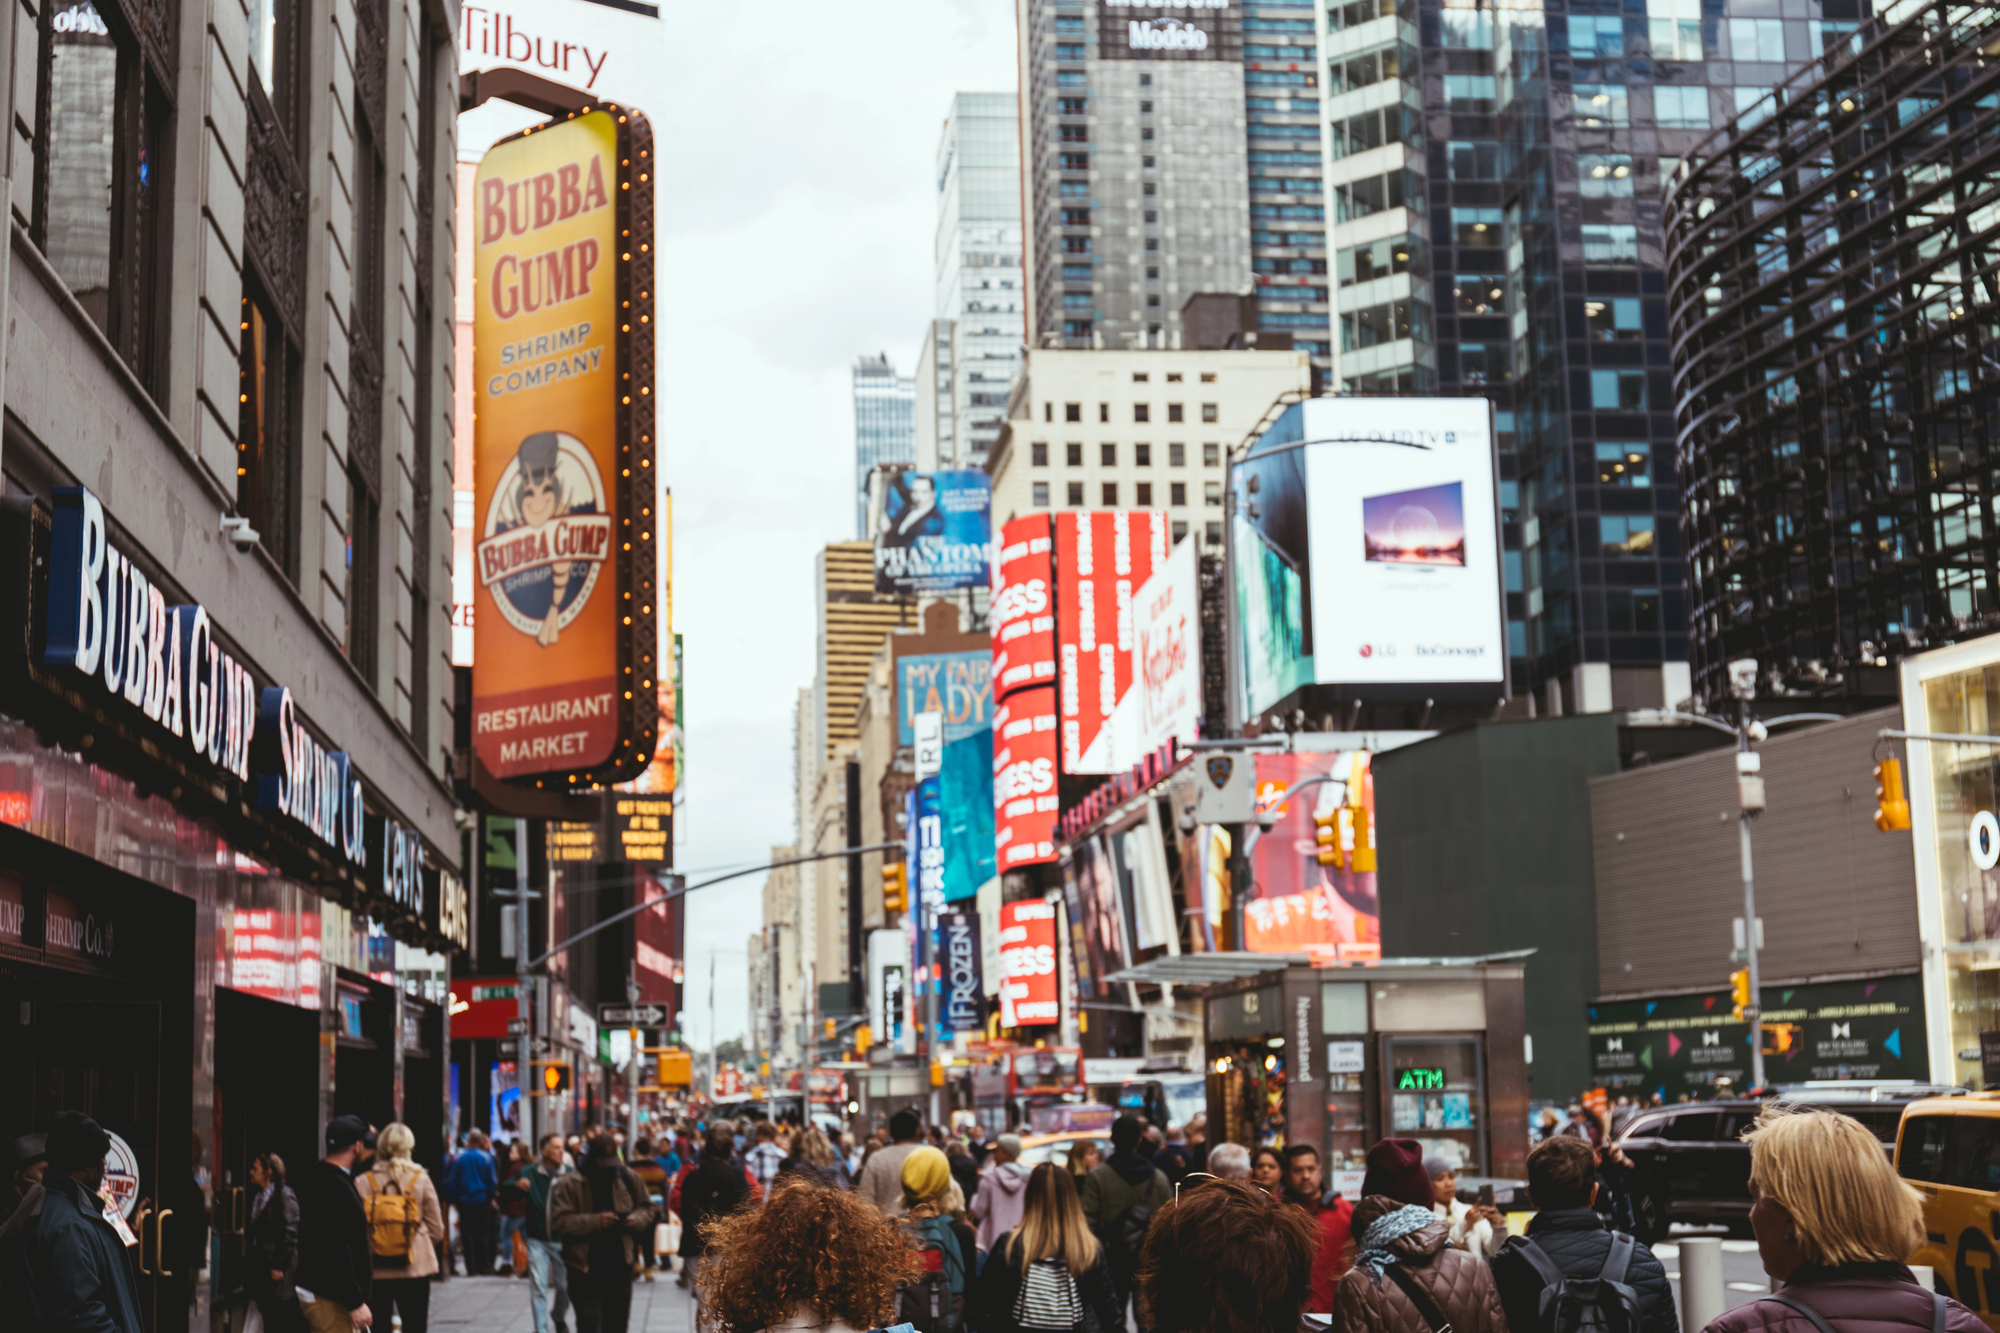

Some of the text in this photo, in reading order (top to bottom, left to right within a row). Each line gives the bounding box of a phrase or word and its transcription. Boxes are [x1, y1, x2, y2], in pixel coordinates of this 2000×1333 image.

[461, 6, 607, 89] Tilbury
[1129, 21, 1208, 50] Modelo
[480, 153, 608, 246] BUBBA
[490, 237, 600, 321] GUMP
[500, 322, 592, 366] SHRIMP
[487, 346, 603, 397] COMPANY
[483, 520, 608, 579] BUBBA GUMP
[504, 566, 550, 593] SHRIMP
[76, 485, 184, 738] BUBBA
[188, 604, 256, 782] GUMP
[278, 686, 339, 848] SHRIMP
[907, 657, 991, 688] MY FAIR
[477, 692, 613, 734] RESTAURANT
[907, 683, 991, 727] LADY
[499, 731, 589, 764] MARKET
[948, 925, 979, 1017] FROZEN
[1297, 996, 1313, 1082] Newsstand
[1399, 1068, 1444, 1090] ATM
